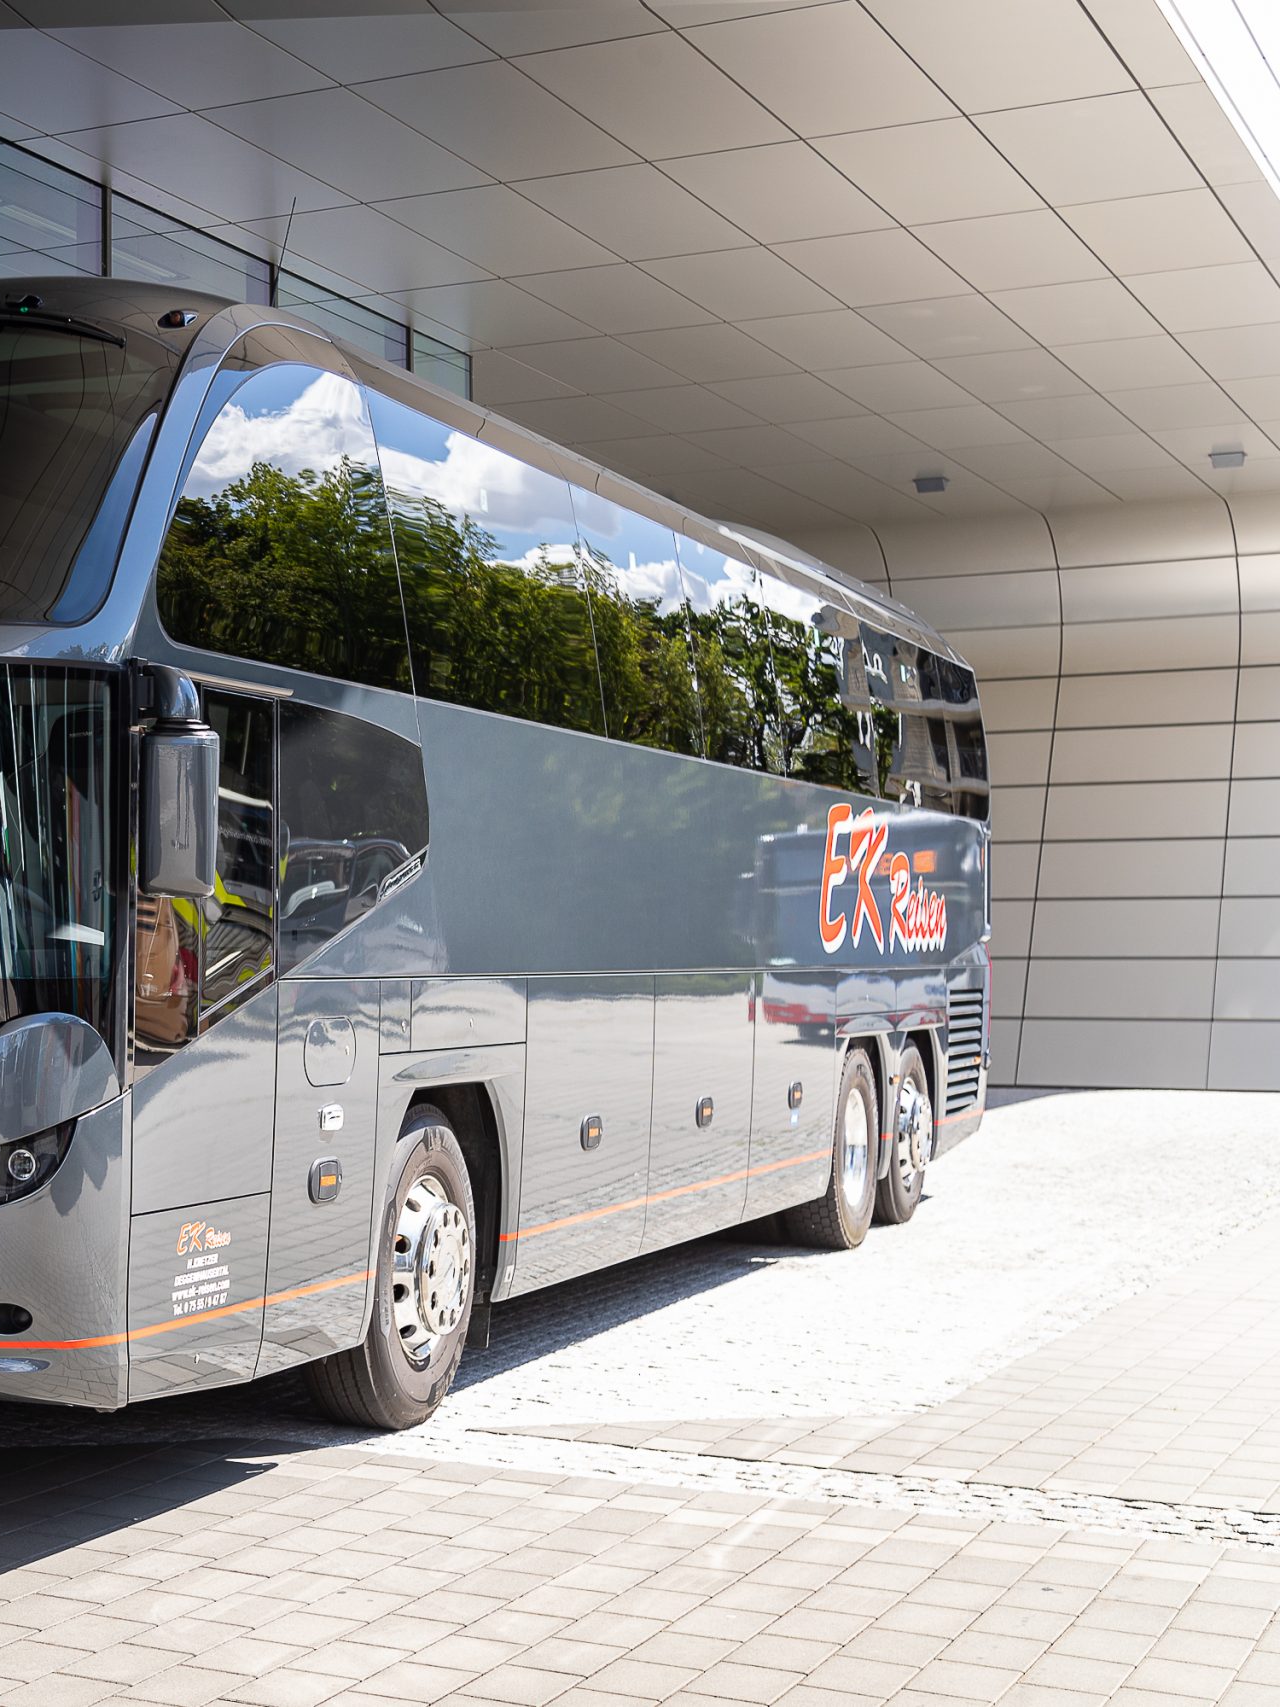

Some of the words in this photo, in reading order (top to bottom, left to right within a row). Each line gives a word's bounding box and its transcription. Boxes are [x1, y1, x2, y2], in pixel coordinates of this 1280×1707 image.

[819, 803, 889, 955] EK
[889, 851, 948, 954] Reisen
[176, 1221, 207, 1256] EK
